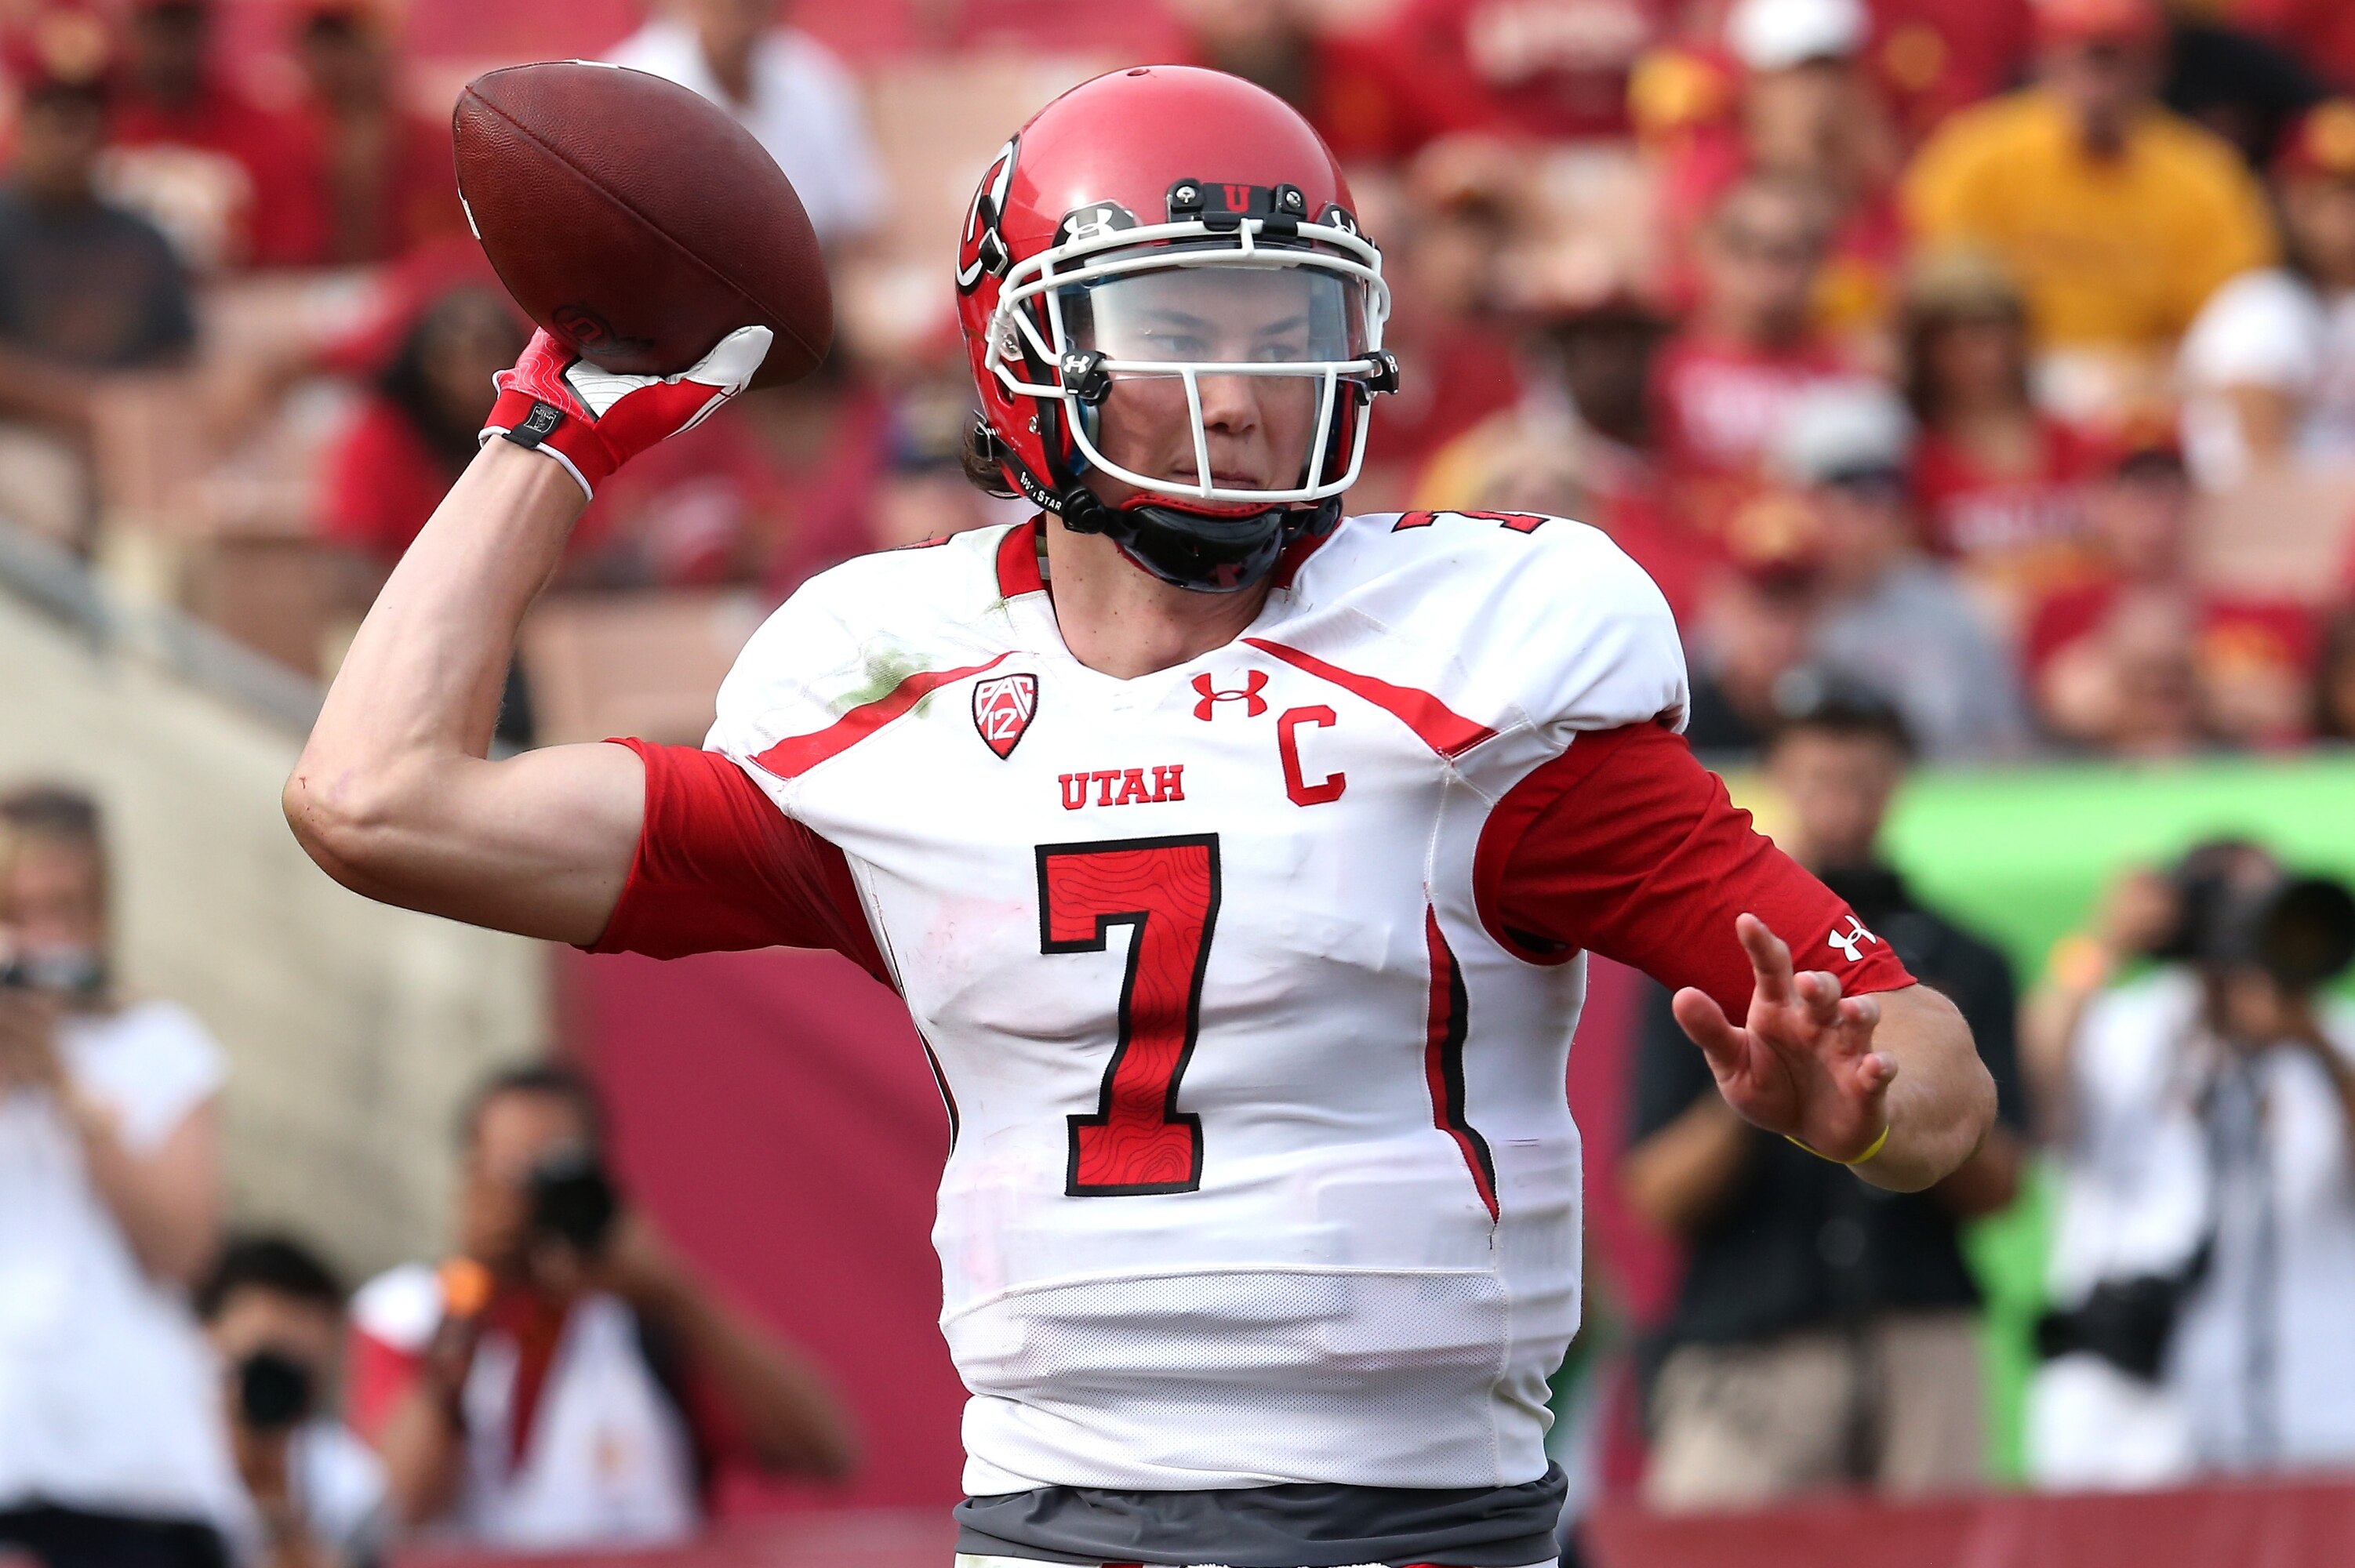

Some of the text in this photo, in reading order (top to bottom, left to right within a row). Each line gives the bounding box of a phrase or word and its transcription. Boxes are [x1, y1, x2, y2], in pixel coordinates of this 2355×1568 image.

[1223, 183, 1252, 213] U
[975, 675, 1034, 726] PAC
[987, 706, 1019, 741] 12
[1277, 704, 1346, 808] C
[1058, 764, 1185, 811] UTAH
[1034, 832, 1222, 1197] 7
